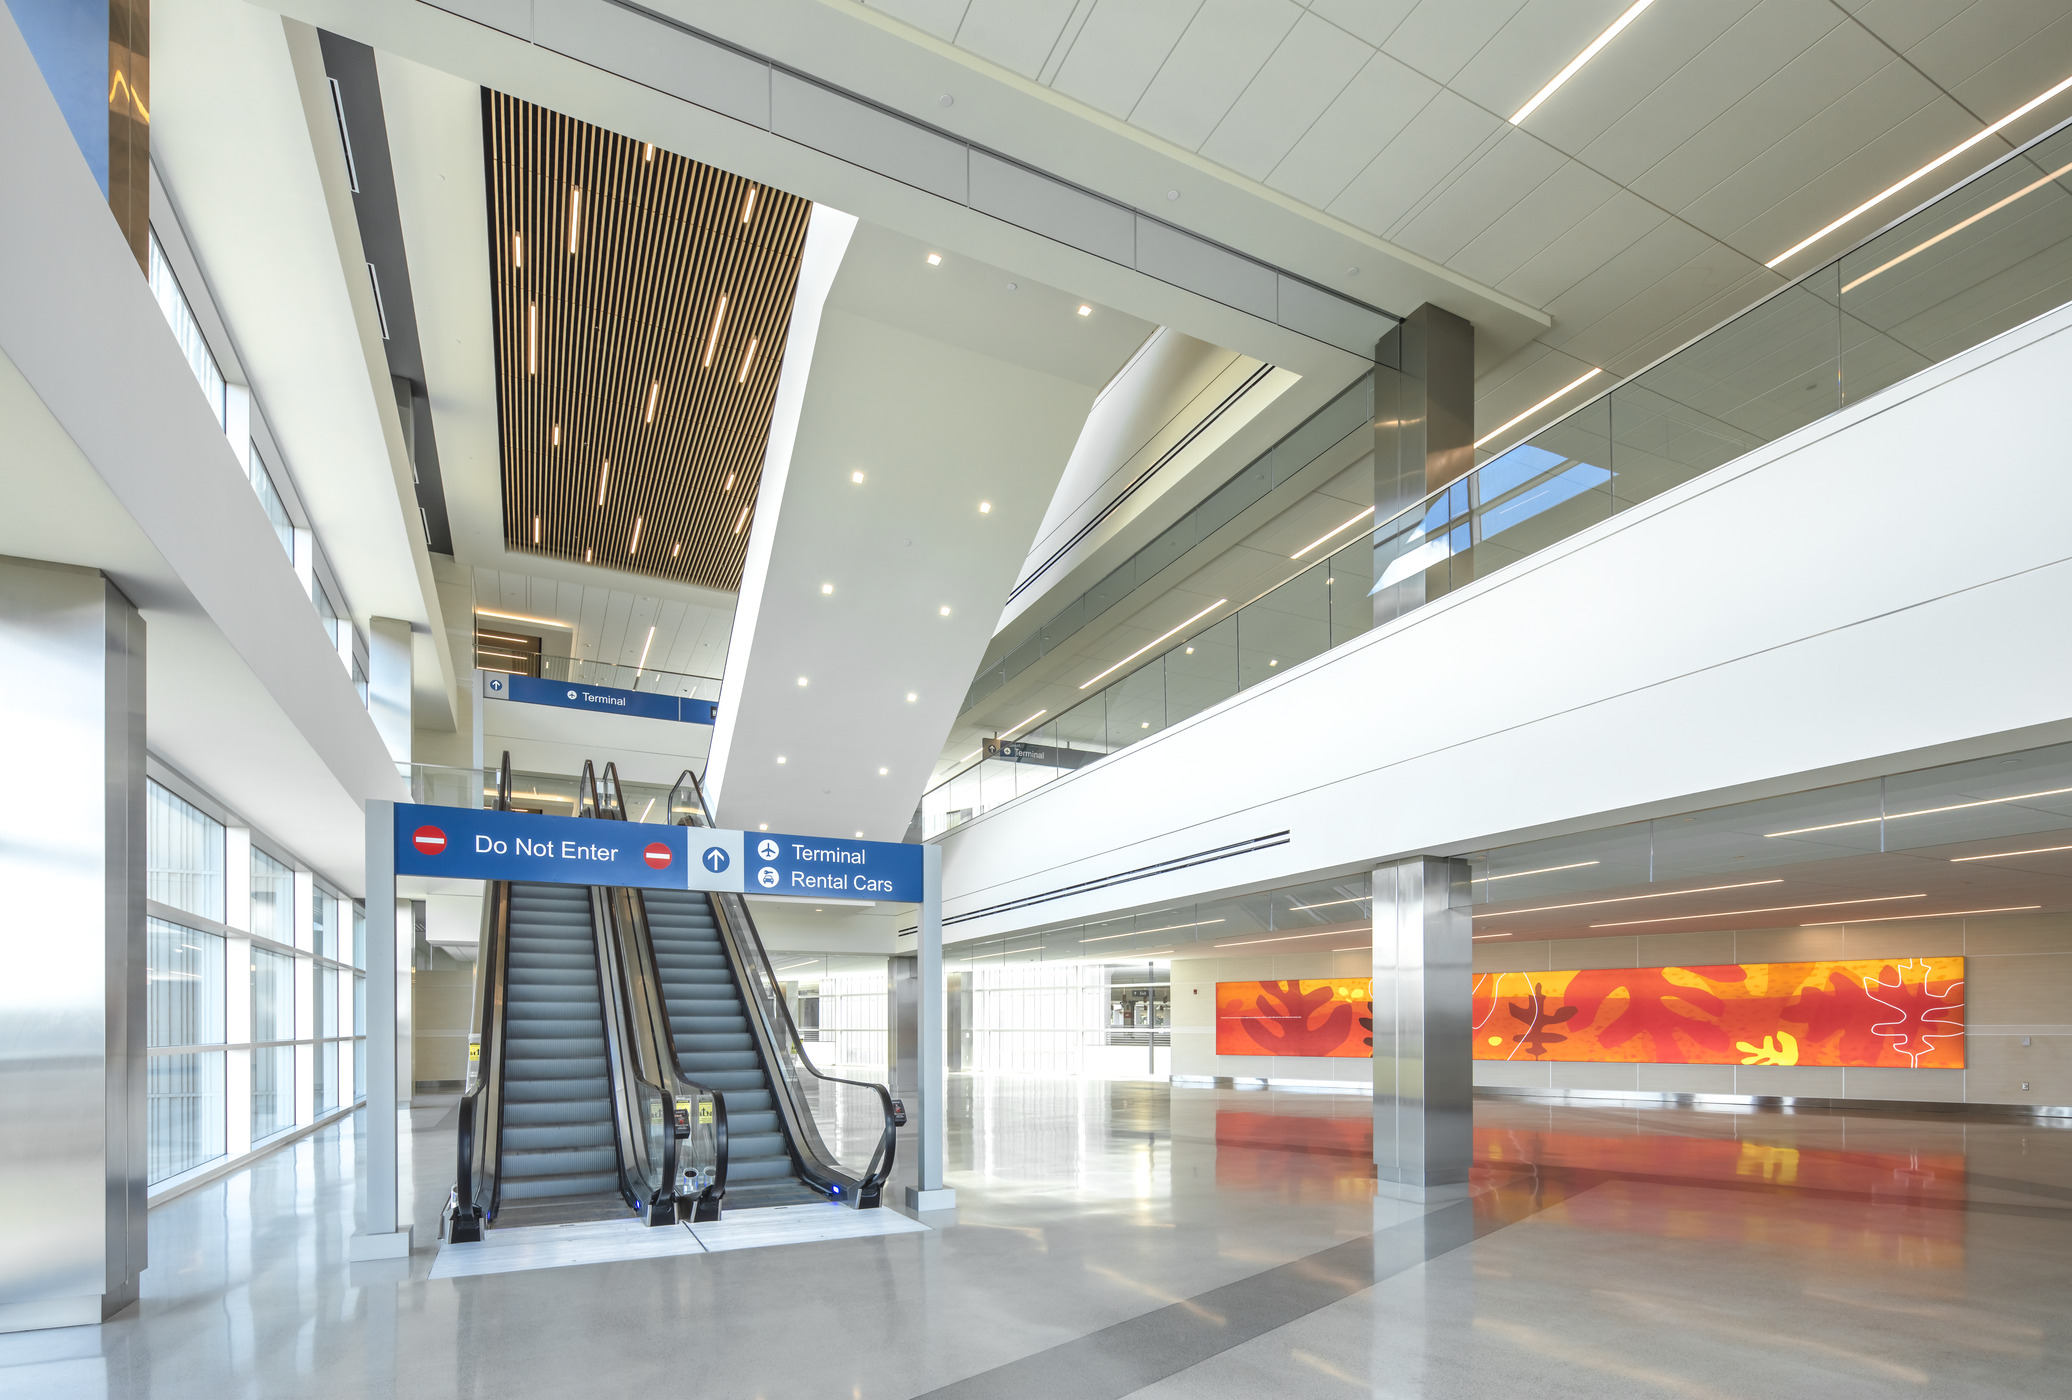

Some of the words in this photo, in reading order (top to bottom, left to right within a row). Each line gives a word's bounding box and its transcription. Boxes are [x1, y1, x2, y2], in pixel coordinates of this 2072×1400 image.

[582, 691, 626, 706] Terminal
[1014, 748, 1045, 760] Terminal
[475, 834, 507, 855] Do
[515, 837, 554, 858] Not
[561, 840, 619, 862] Enter
[791, 843, 866, 865] Terminal
[791, 871, 848, 890] Rental
[853, 875, 893, 892] Cars
